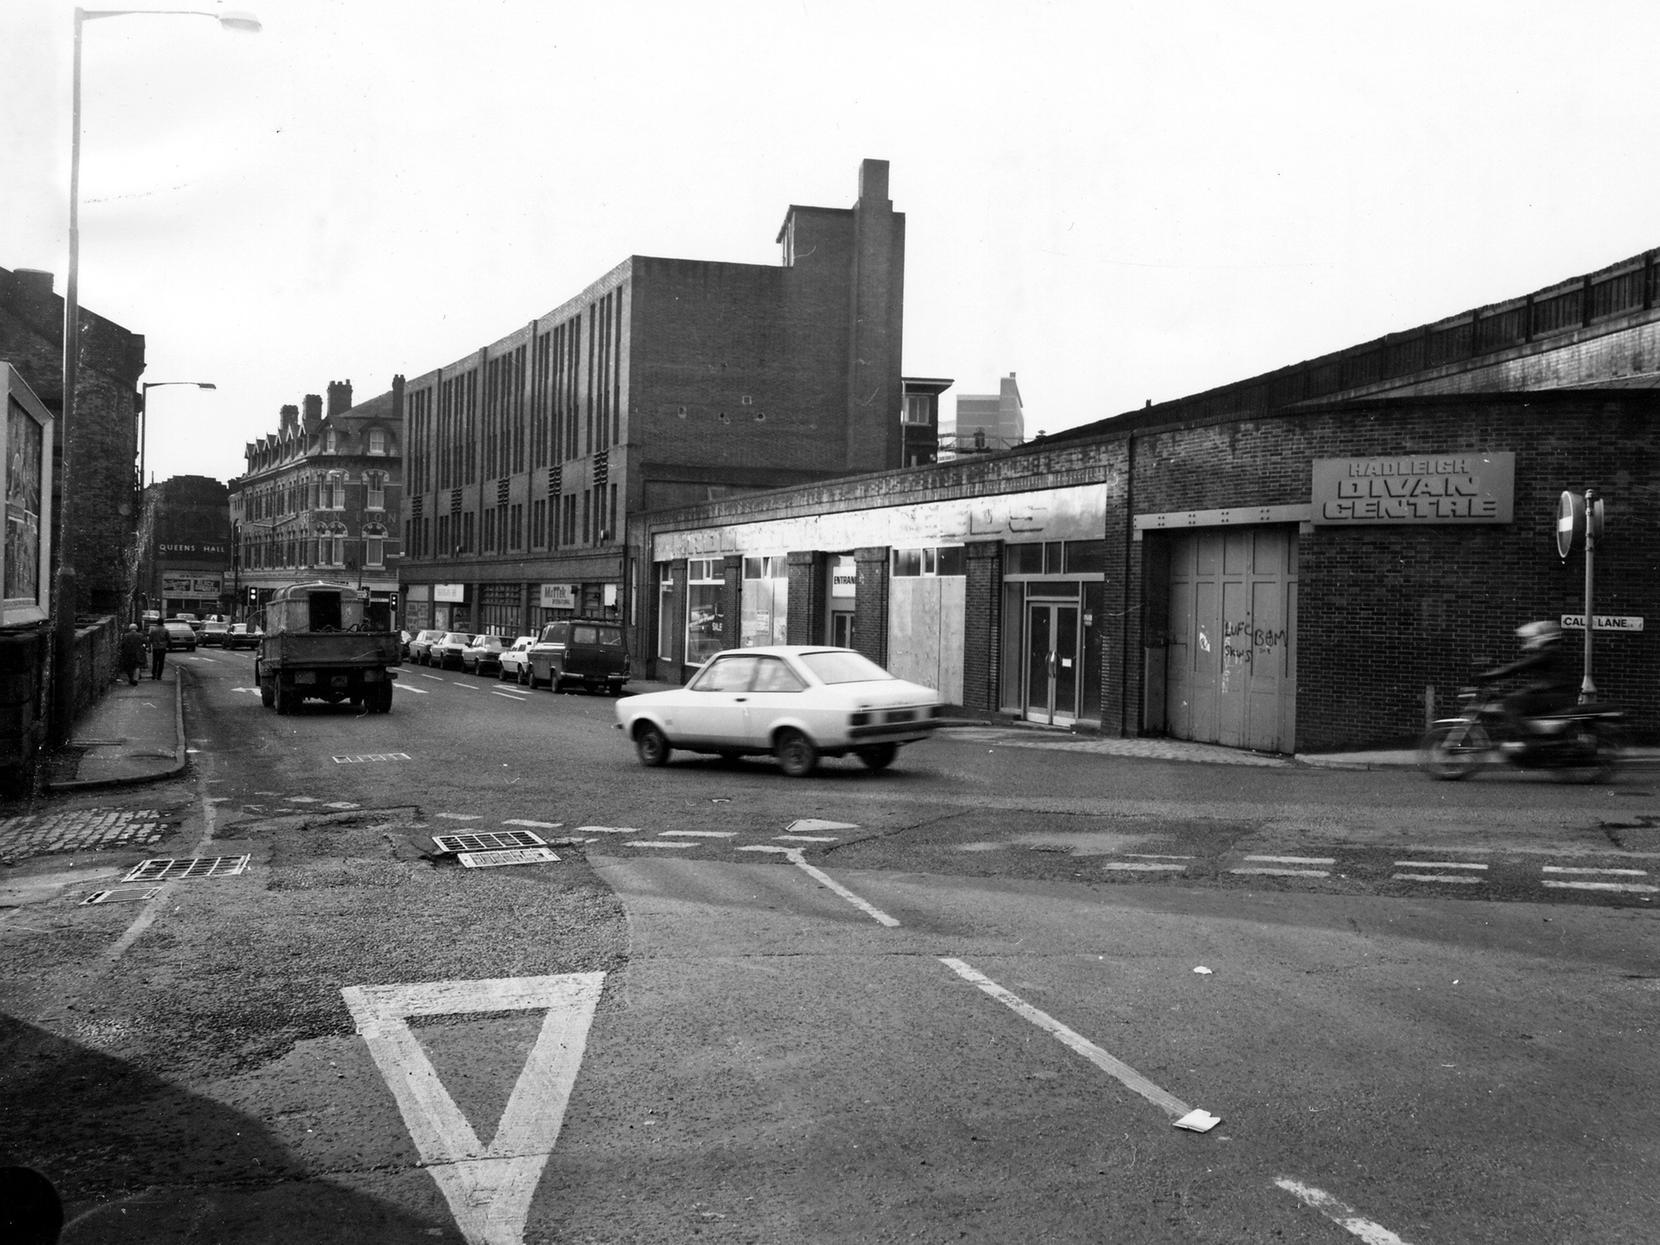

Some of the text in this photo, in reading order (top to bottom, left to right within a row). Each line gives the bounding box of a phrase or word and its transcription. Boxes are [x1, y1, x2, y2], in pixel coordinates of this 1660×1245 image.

[1350, 459, 1470, 477] HADLEIGH
[1338, 477, 1479, 499] DIVAN
[1323, 498, 1496, 519] CENTRE
[159, 544, 225, 553] QUEENS HALL
[1563, 616, 1588, 627] CAL
[1597, 618, 1628, 628] LANE
